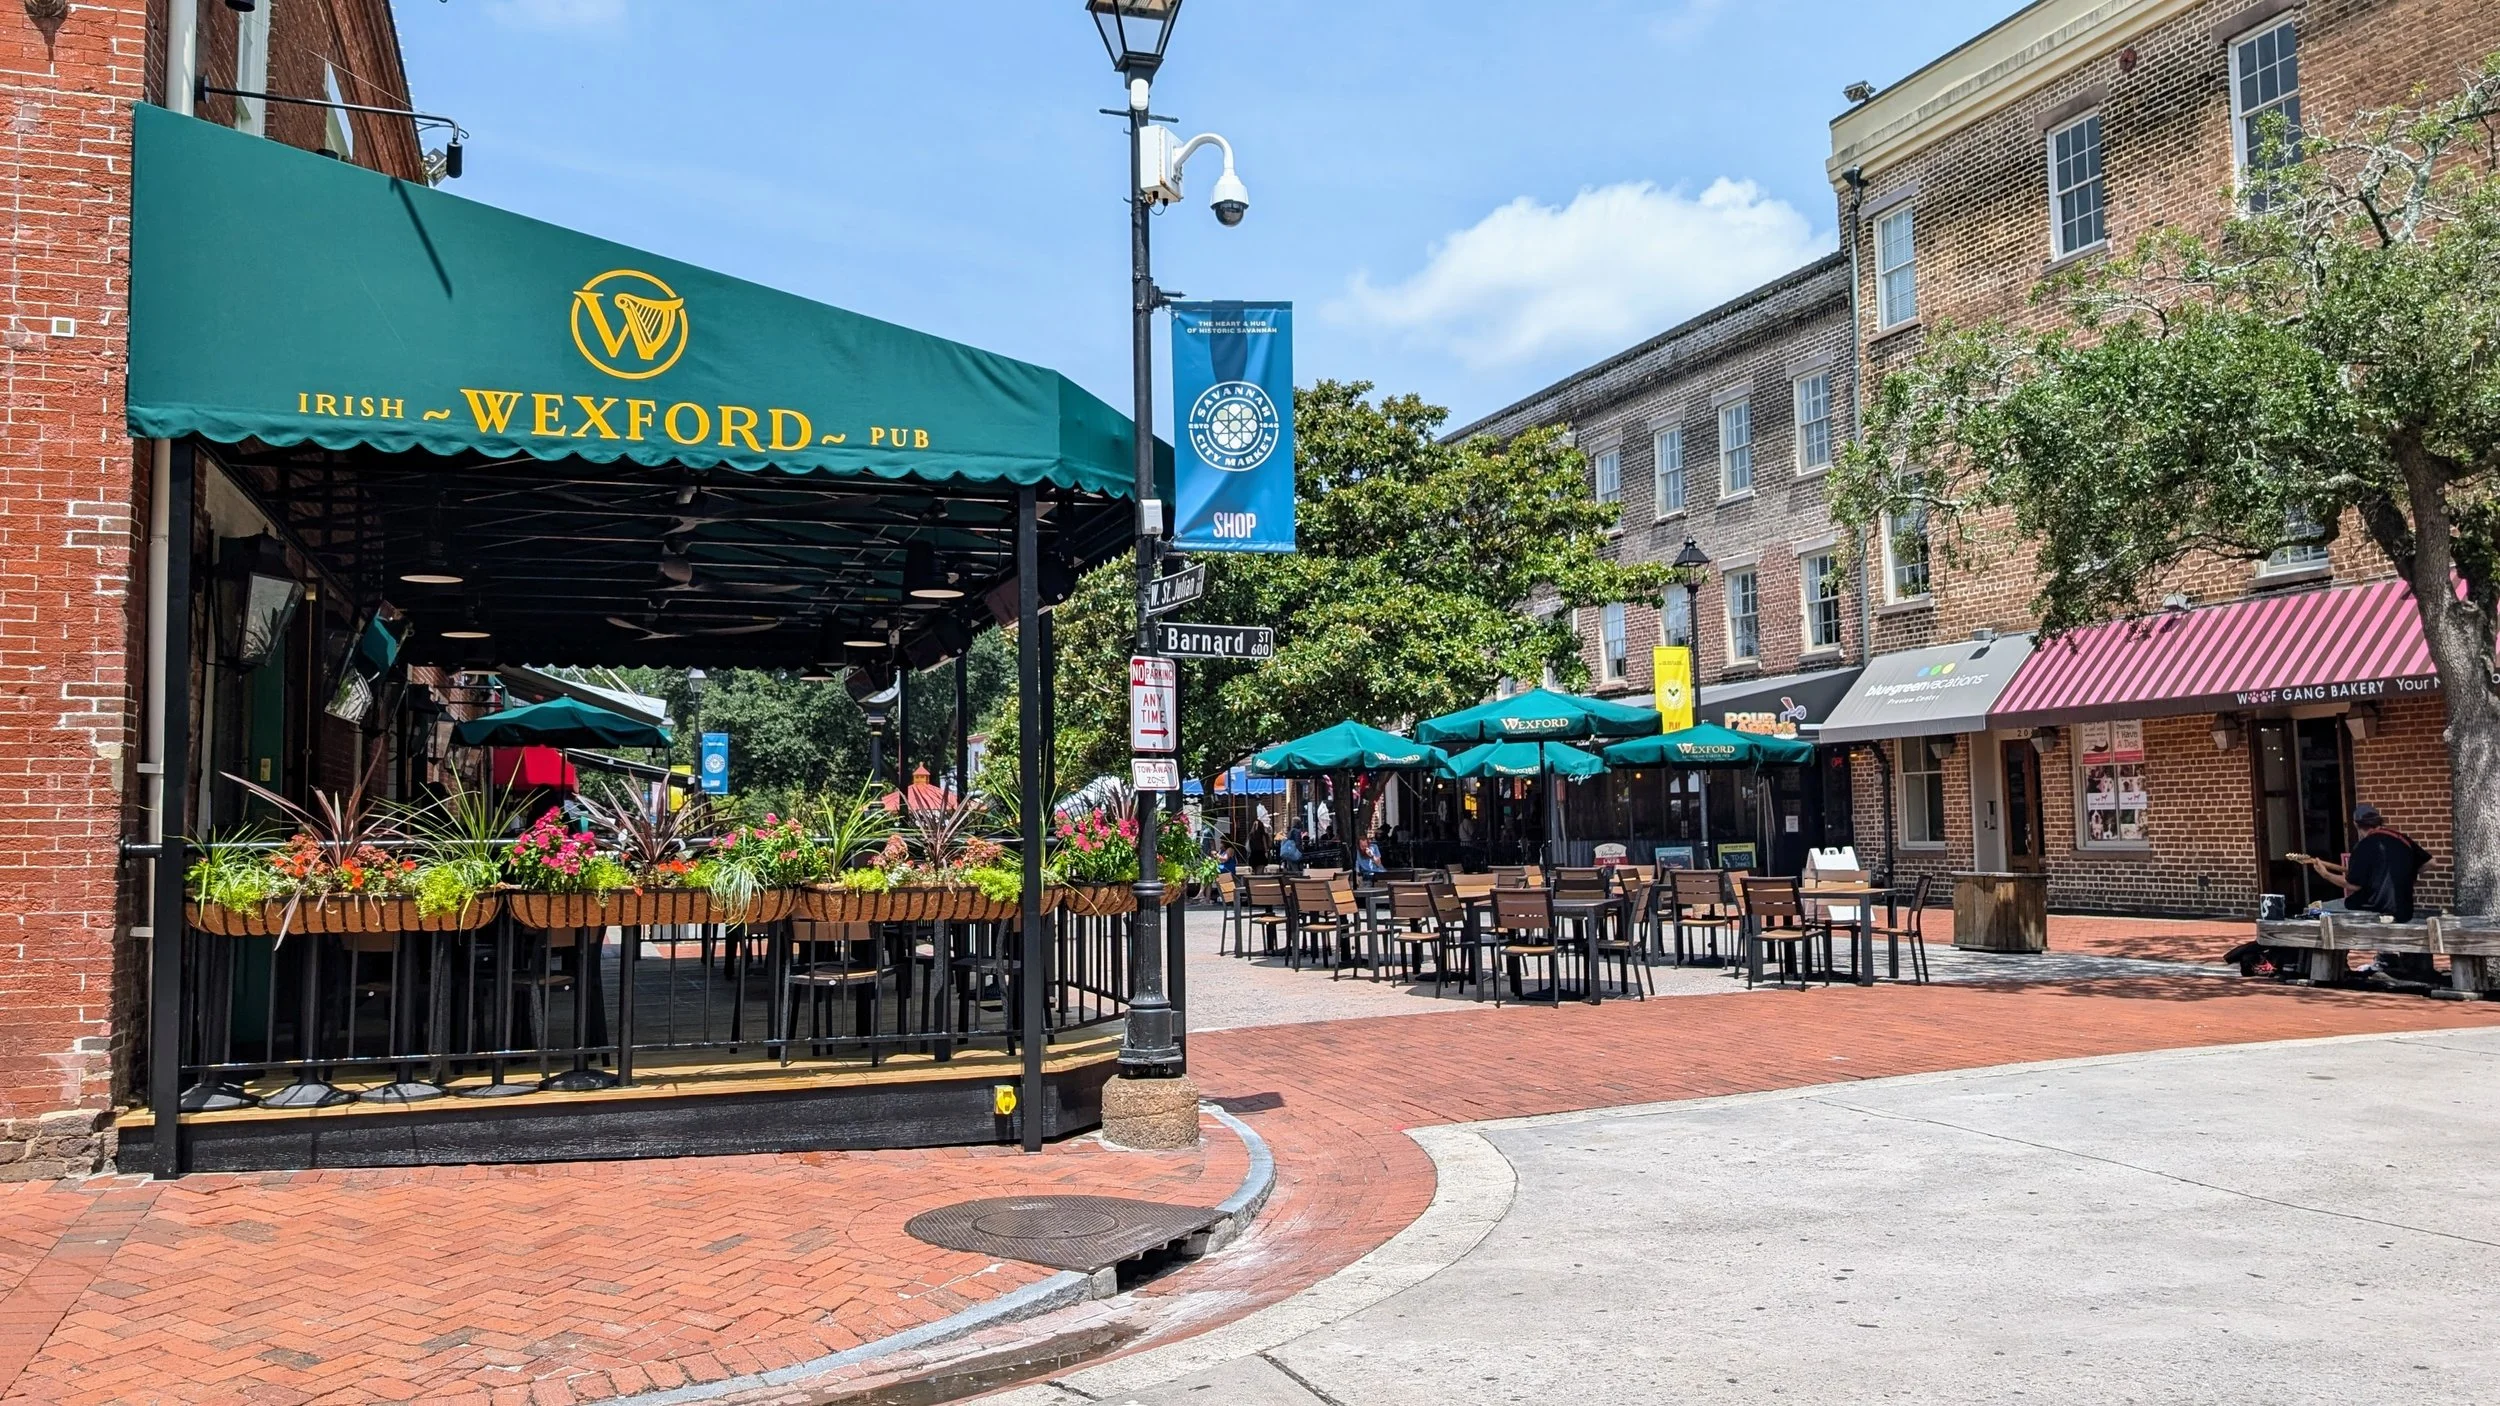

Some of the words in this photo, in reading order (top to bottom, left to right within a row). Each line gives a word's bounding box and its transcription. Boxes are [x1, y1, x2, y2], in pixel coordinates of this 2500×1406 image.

[1197, 387, 1271, 418] SAVANNAH
[298, 393, 404, 418] IRISH
[460, 388, 813, 452] WEXFORD
[870, 427, 929, 449] PUB
[1197, 434, 1221, 462] CITY
[1225, 433, 1272, 466] MARKET
[1213, 511, 1256, 538] SHOP
[1162, 581, 1171, 604] St.
[1172, 575, 1194, 601] Julian
[1168, 627, 1243, 653] Barnard
[1258, 631, 1269, 643] ST
[1251, 643, 1269, 655] 600
[1132, 663, 1144, 682] NO
[1145, 668, 1173, 681] PARKING
[2283, 686, 2325, 701] GANG
[2331, 681, 2385, 698] BAKERY
[2396, 676, 2429, 692] Your
[1143, 693, 1163, 707] ANY
[1886, 697, 1914, 705] Preview
[1915, 694, 1940, 703] Center
[1141, 709, 1166, 724] TIME
[1500, 717, 1569, 730] WEXFORD
[1677, 743, 1735, 754] WEXFORD
[1136, 765, 1173, 774] TOW-AWAY
